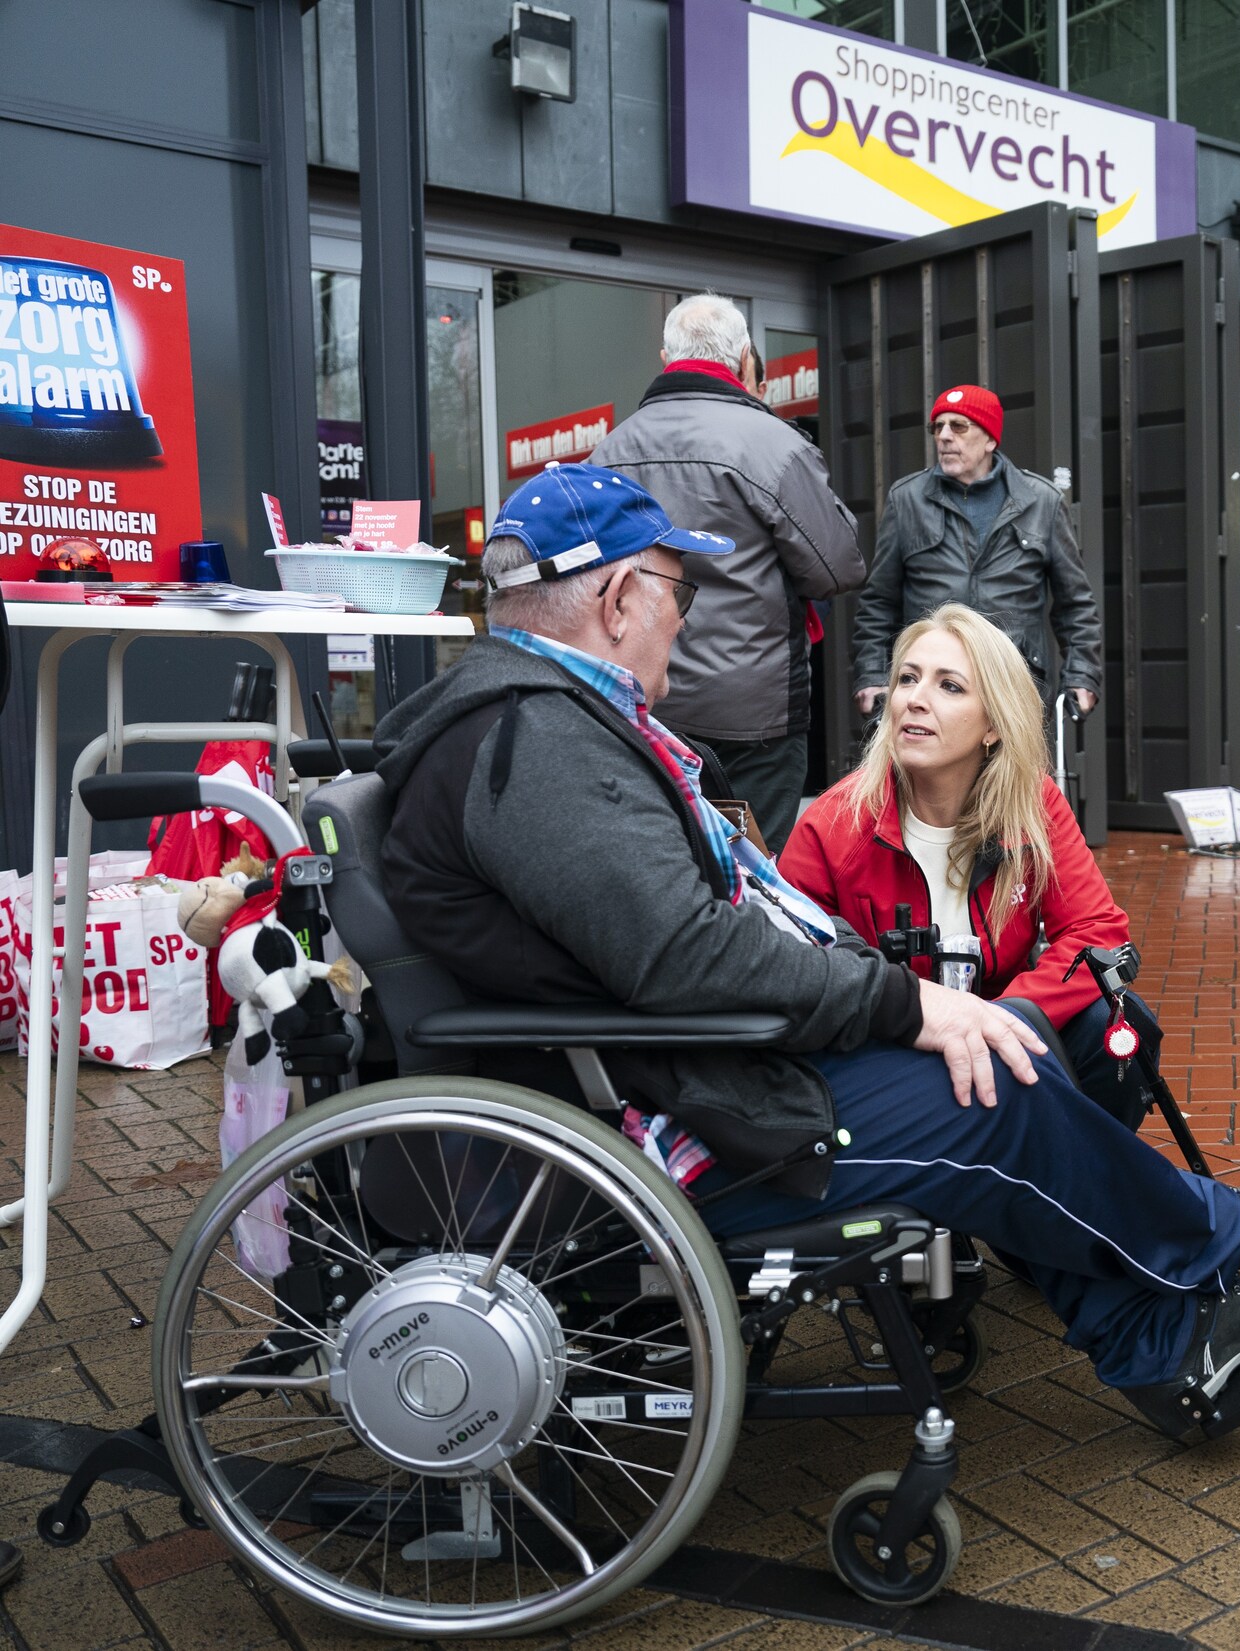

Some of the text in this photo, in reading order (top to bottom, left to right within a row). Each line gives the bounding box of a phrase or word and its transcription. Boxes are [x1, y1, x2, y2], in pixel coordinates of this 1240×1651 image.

[836, 44, 1061, 131] Shoppingcenter
[791, 70, 1117, 204] Overvecht
[37, 273, 107, 304] grote
[0, 300, 119, 367] zorg
[0, 353, 131, 411] alarm
[510, 417, 608, 469] Dirk van den Broek
[23, 474, 117, 504] STOP DE
[318, 461, 360, 480] om!
[0, 502, 157, 535] EZUINIGINGEN
[96, 538, 153, 563] ZORG
[368, 1312, 430, 1359] e-move
[436, 1410, 499, 1455] e-move
